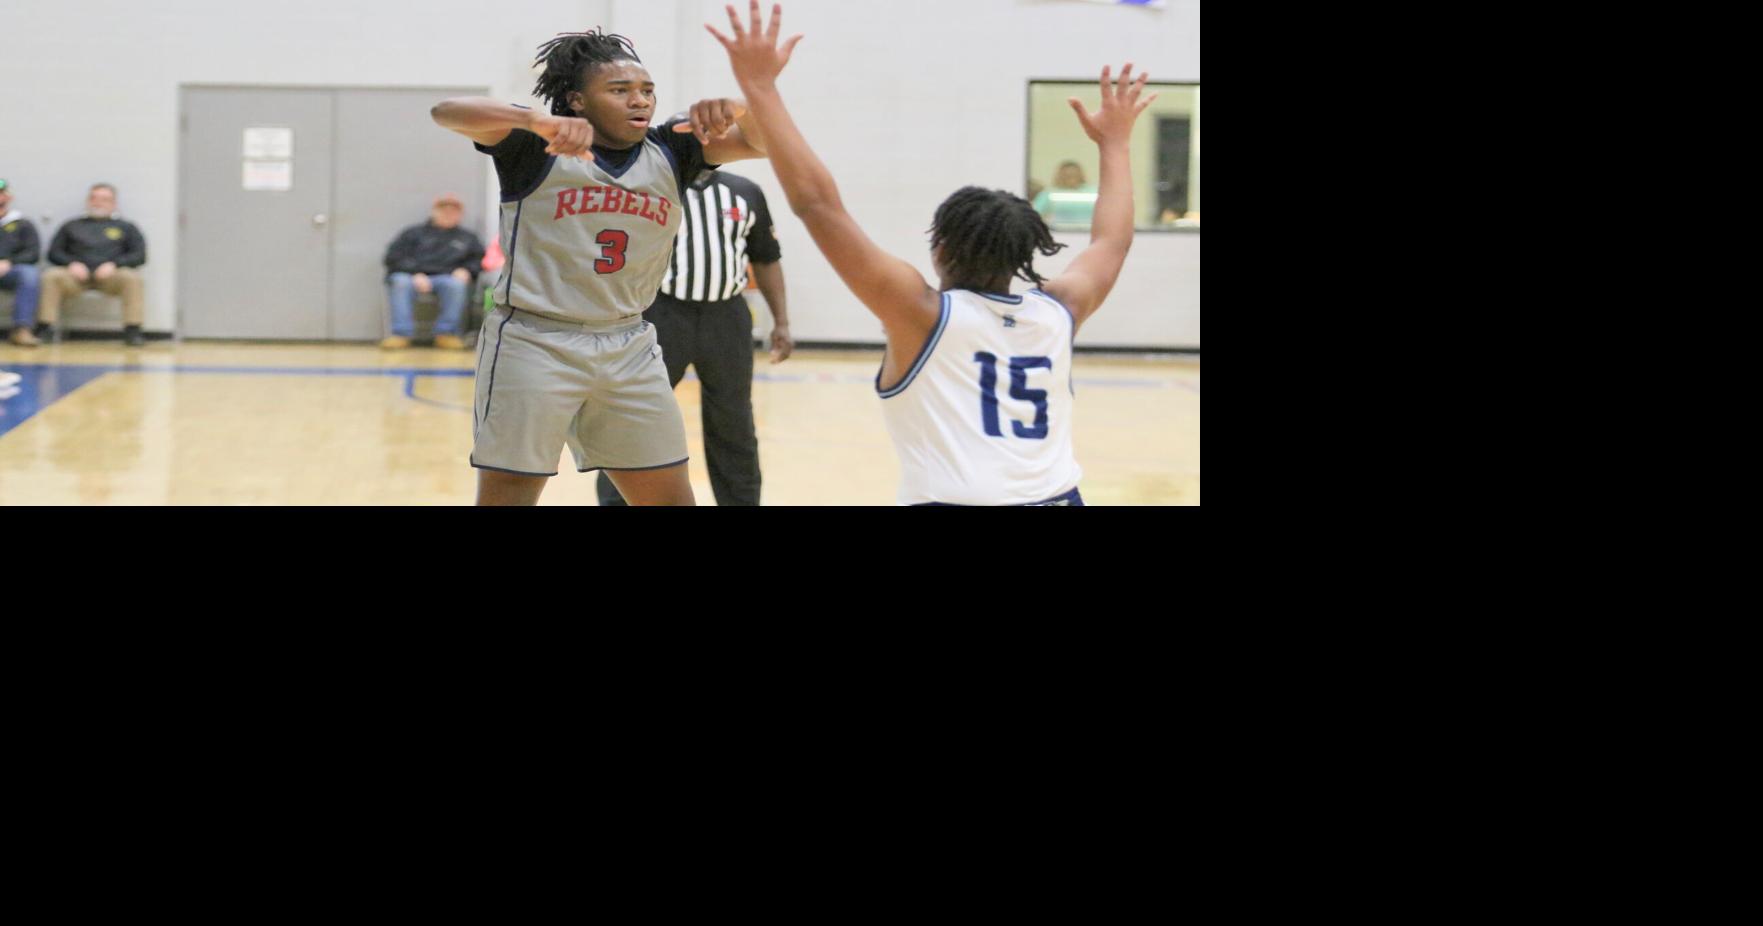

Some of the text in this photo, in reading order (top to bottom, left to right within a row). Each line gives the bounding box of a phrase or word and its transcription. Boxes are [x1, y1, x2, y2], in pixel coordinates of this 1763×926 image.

[554, 185, 671, 226] REBELS
[594, 229, 629, 274] 3
[974, 351, 1051, 439] 15
